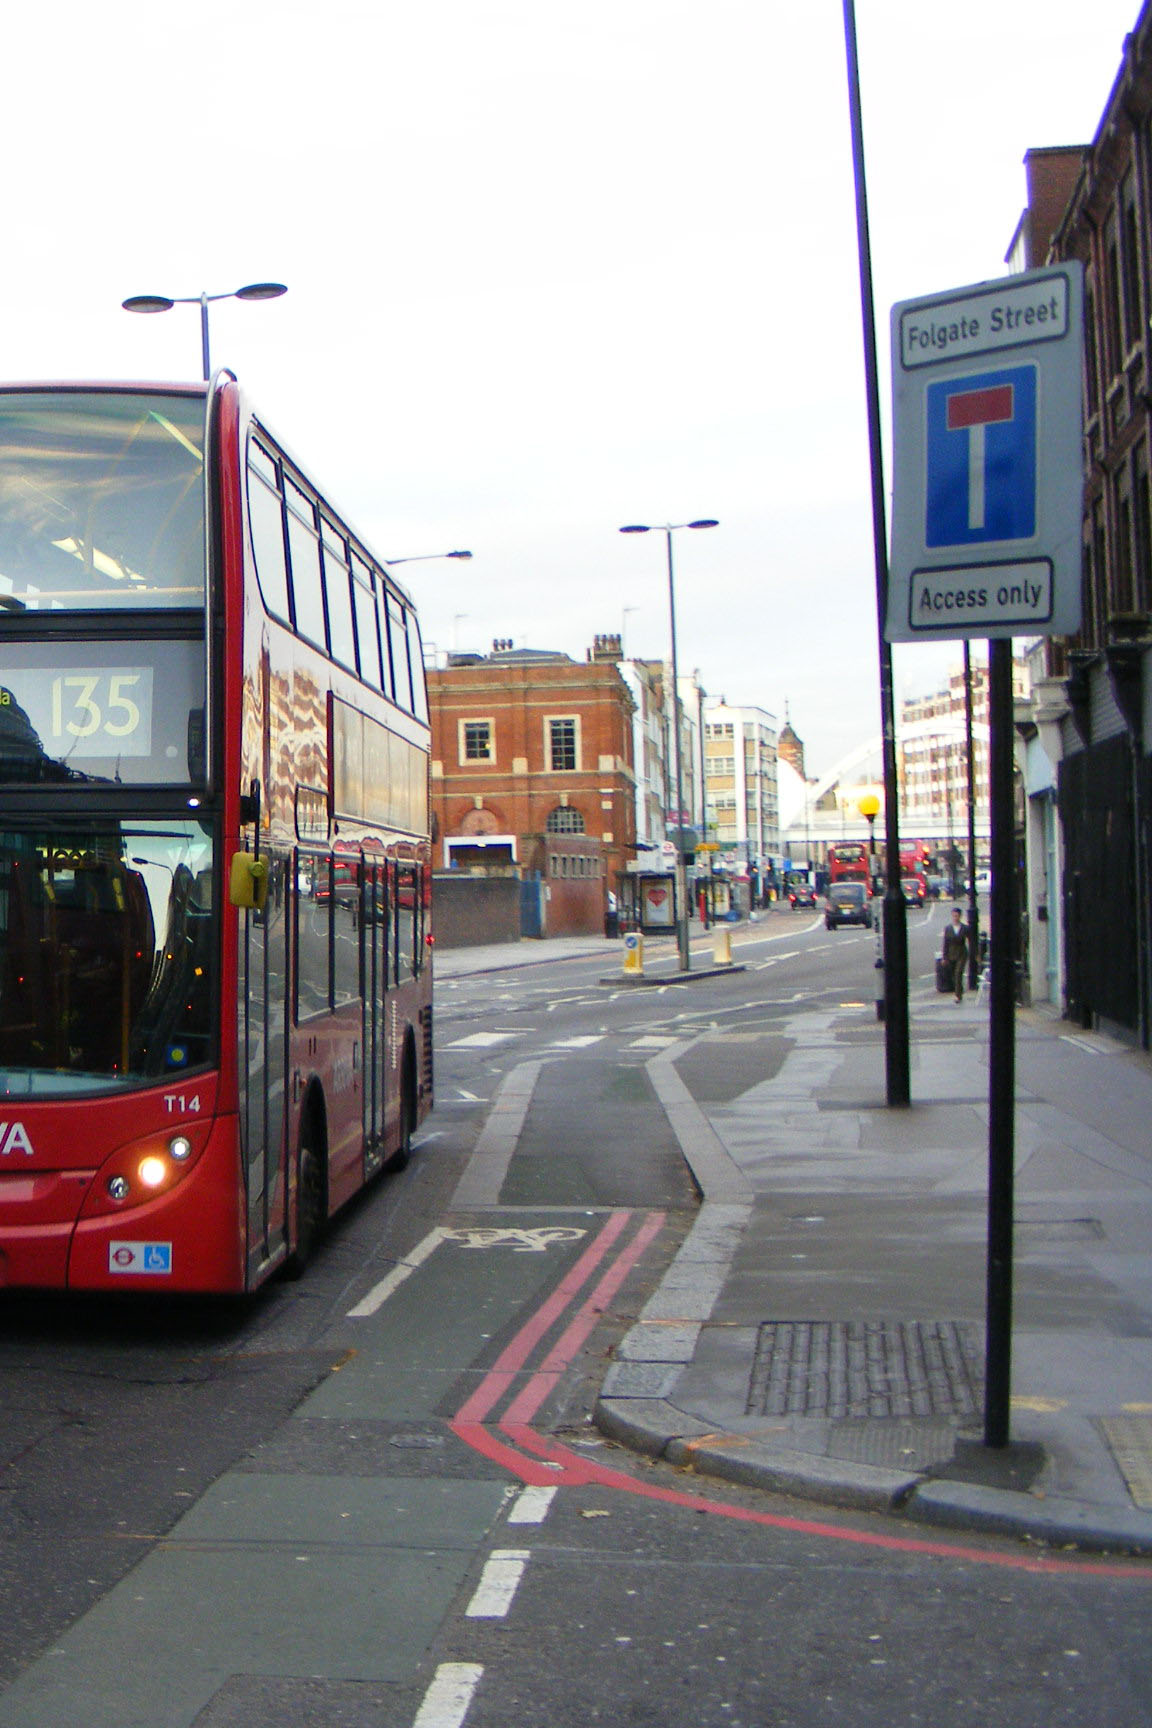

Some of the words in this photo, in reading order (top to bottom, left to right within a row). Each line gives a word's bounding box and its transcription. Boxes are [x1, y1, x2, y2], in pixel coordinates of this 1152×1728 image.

[908, 316, 980, 350] Folgate
[991, 298, 1058, 332] Street
[920, 587, 988, 610] Access
[997, 580, 1043, 608] only
[51, 675, 140, 738] 135
[164, 1095, 201, 1113] T14
